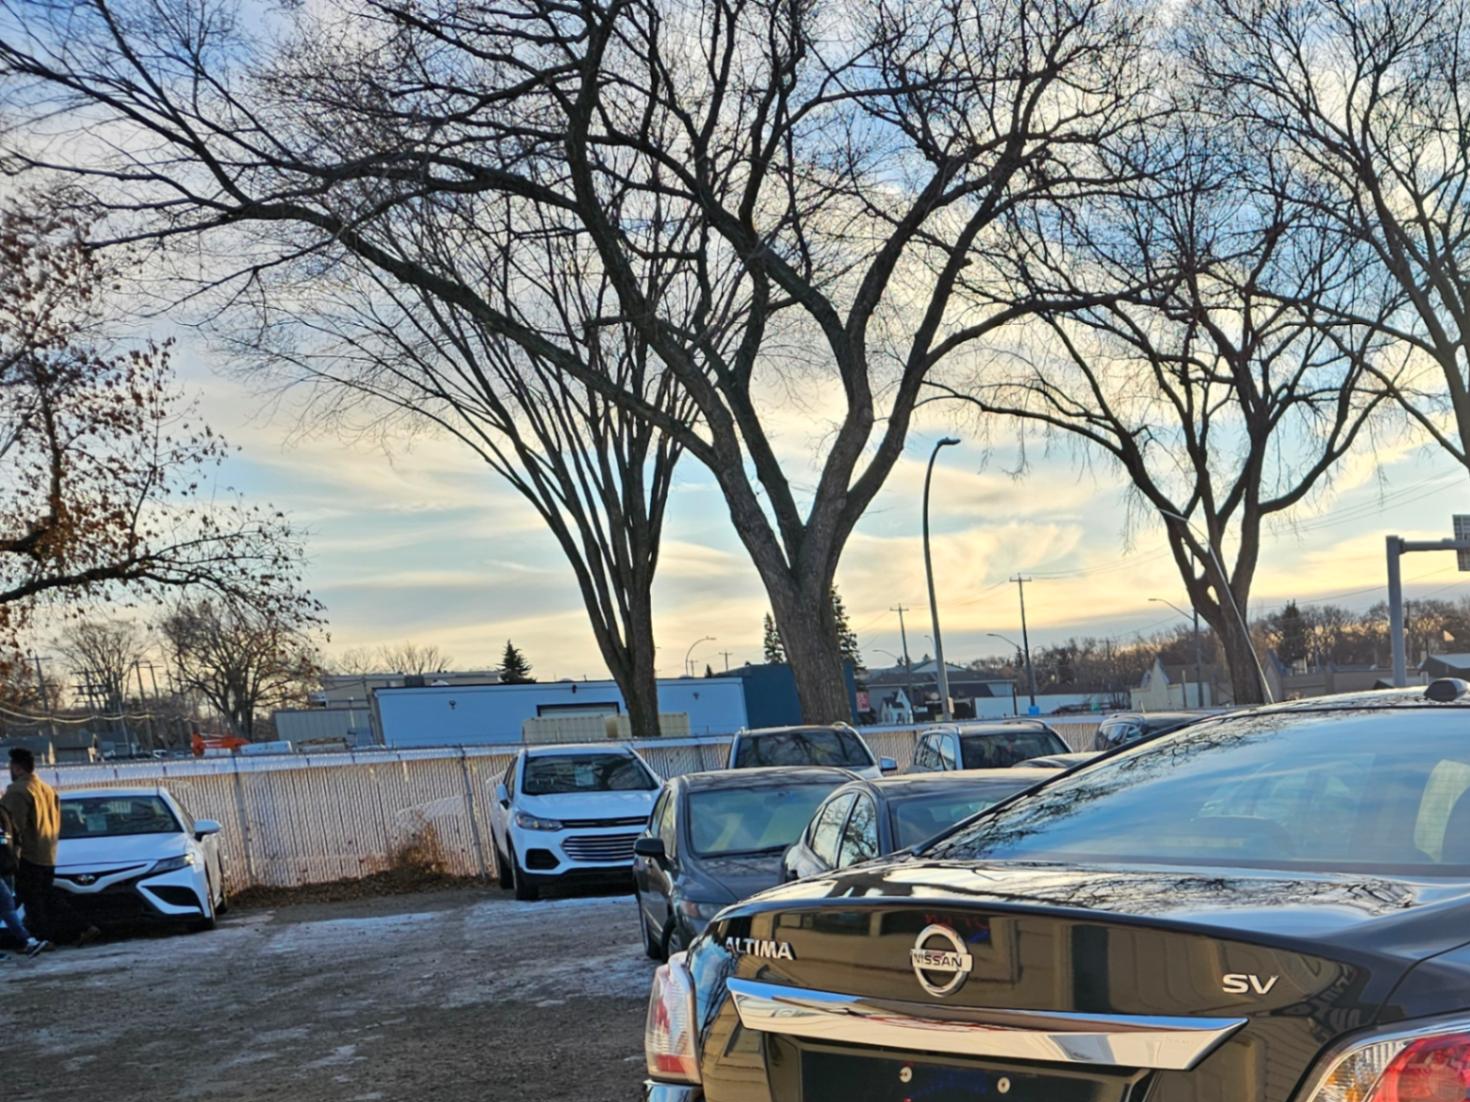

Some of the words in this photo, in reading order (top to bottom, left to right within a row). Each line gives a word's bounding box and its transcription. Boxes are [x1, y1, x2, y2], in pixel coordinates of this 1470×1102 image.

[725, 936, 797, 961] ALTIMA
[913, 951, 963, 968] NISSAN
[1222, 973, 1280, 994] SV
